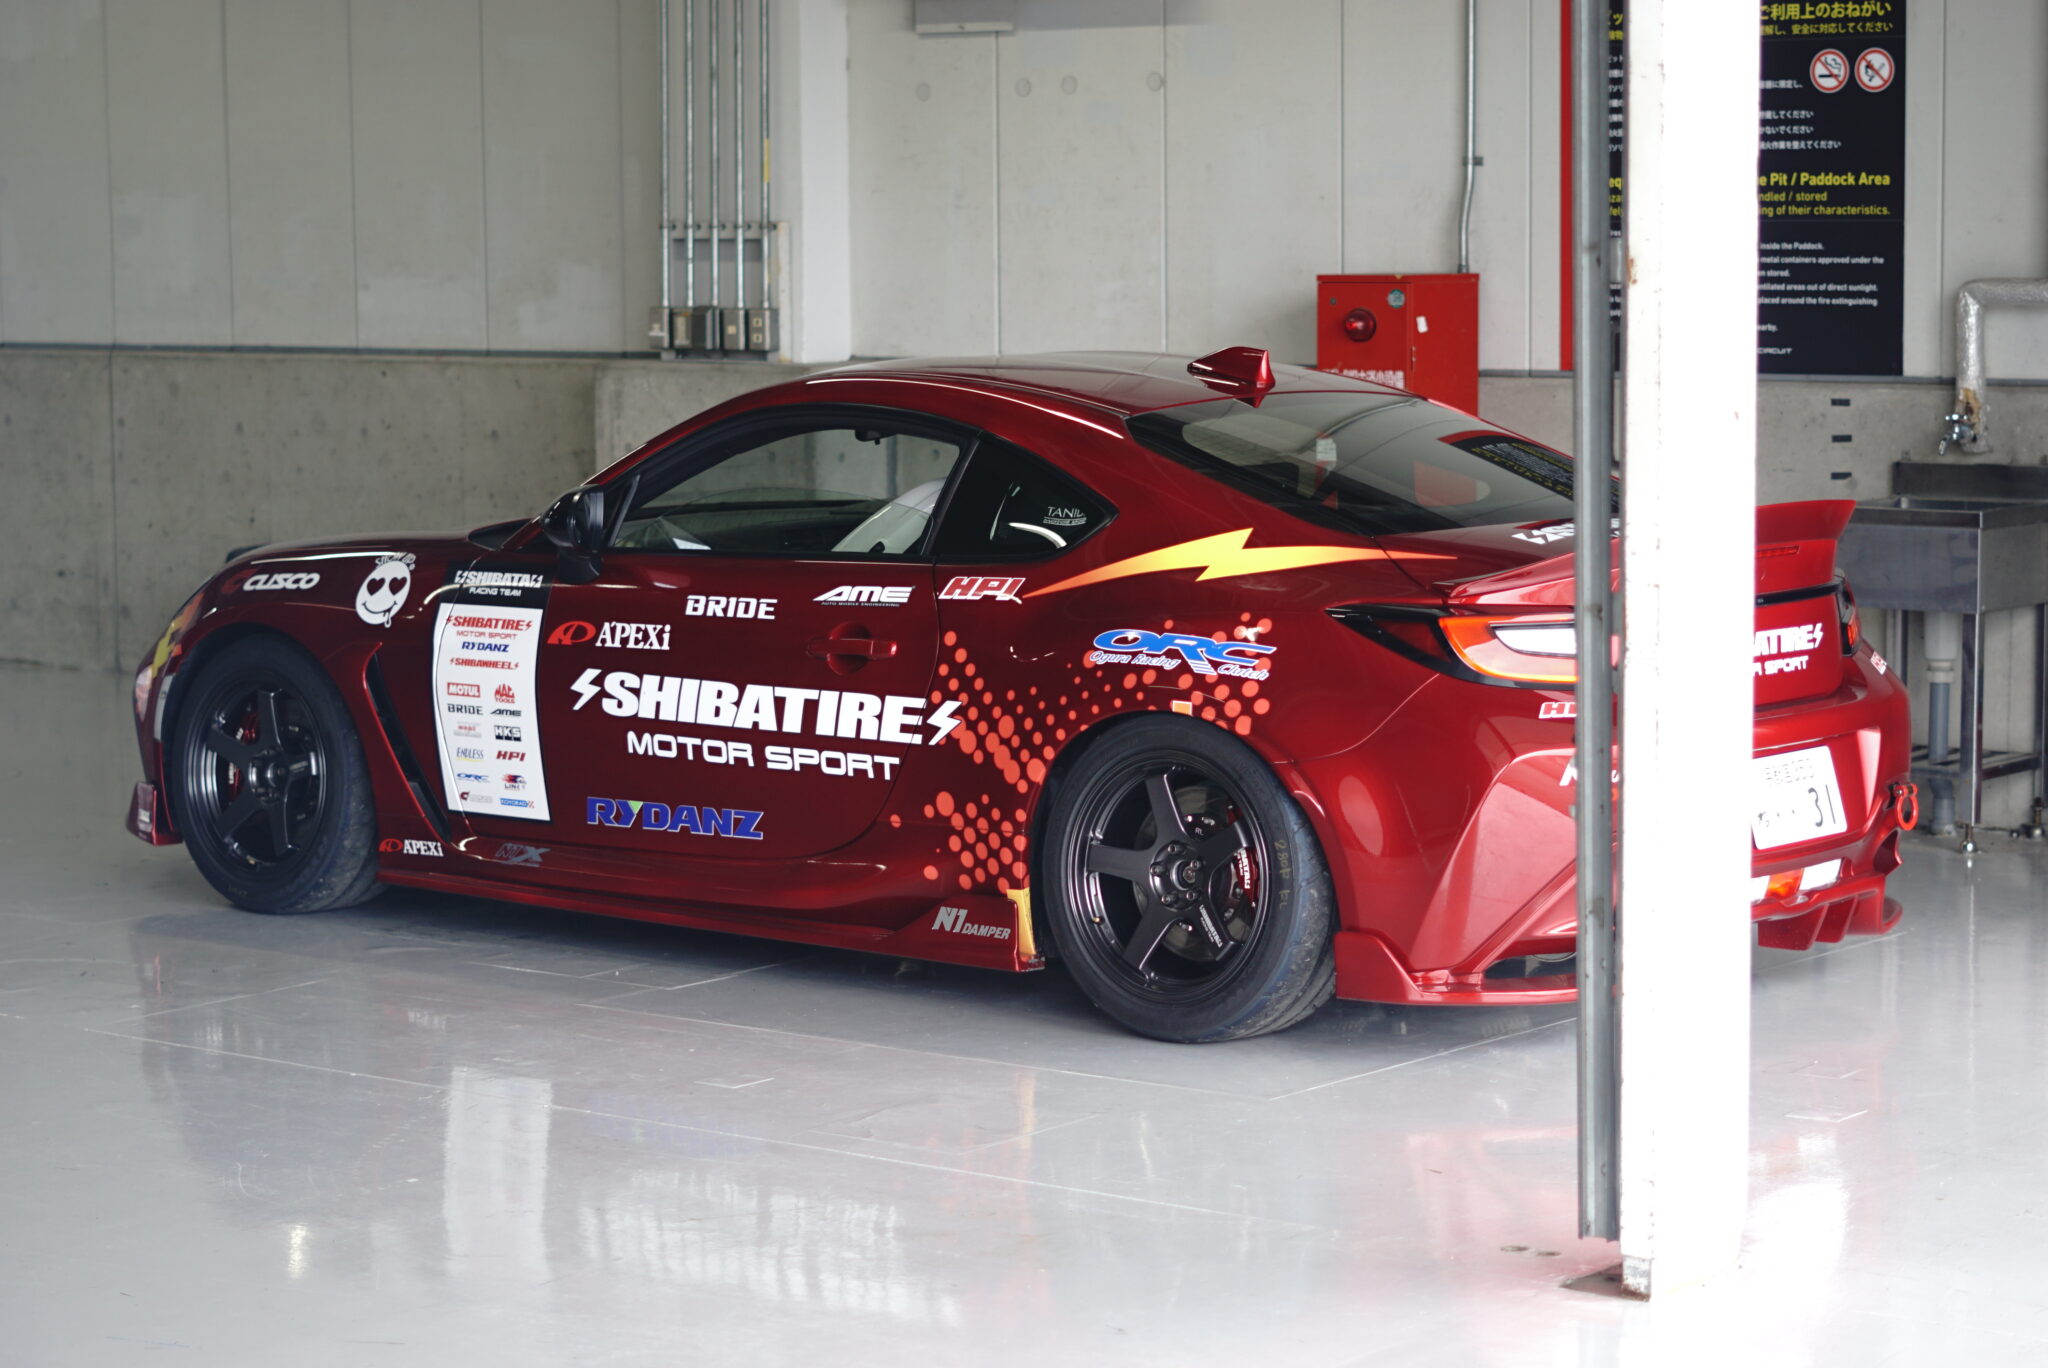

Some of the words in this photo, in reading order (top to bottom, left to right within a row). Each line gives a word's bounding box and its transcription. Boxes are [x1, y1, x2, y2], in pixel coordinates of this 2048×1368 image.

[1770, 173, 1788, 186] Pit
[1791, 172, 1797, 186] /
[1800, 172, 1855, 185] Paddock
[1858, 172, 1891, 185] Area
[1759, 191, 1786, 201] ndled
[1796, 191, 1827, 201] stored
[1776, 205, 1786, 215] of
[1788, 205, 1811, 215] their
[1813, 205, 1890, 215] characteristics.
[1781, 242, 1792, 250] the
[1793, 242, 1824, 250] Paddock.
[1818, 257, 1849, 266] approved
[1819, 283, 1827, 291] of
[243, 573, 320, 591] CUSCO
[465, 570, 531, 587] SHIBATA
[469, 587, 498, 595] RACING
[500, 588, 522, 597] TEAM
[685, 595, 778, 620] BRIDE
[452, 616, 525, 631] SHIBATIRE
[488, 632, 518, 640] SPORT
[1756, 624, 1815, 656] ATIRE
[462, 641, 509, 652] RYDANZ
[1090, 651, 1131, 664] Ogura
[1131, 653, 1181, 670] Racing
[1217, 663, 1270, 681] Clutch
[1764, 655, 1809, 675] SPORT
[448, 684, 480, 697] MOTUL
[447, 704, 483, 715] BRIDE
[601, 671, 926, 745] SHIBATIRE
[494, 725, 521, 742] HKS
[456, 747, 484, 759] ENDLESS
[496, 751, 526, 762] HPI
[627, 731, 754, 767] MOTOR
[765, 746, 900, 781] SPORT
[586, 797, 764, 840] RYDANZ
[932, 906, 968, 933] N1
[961, 922, 1011, 939] DAMPER
